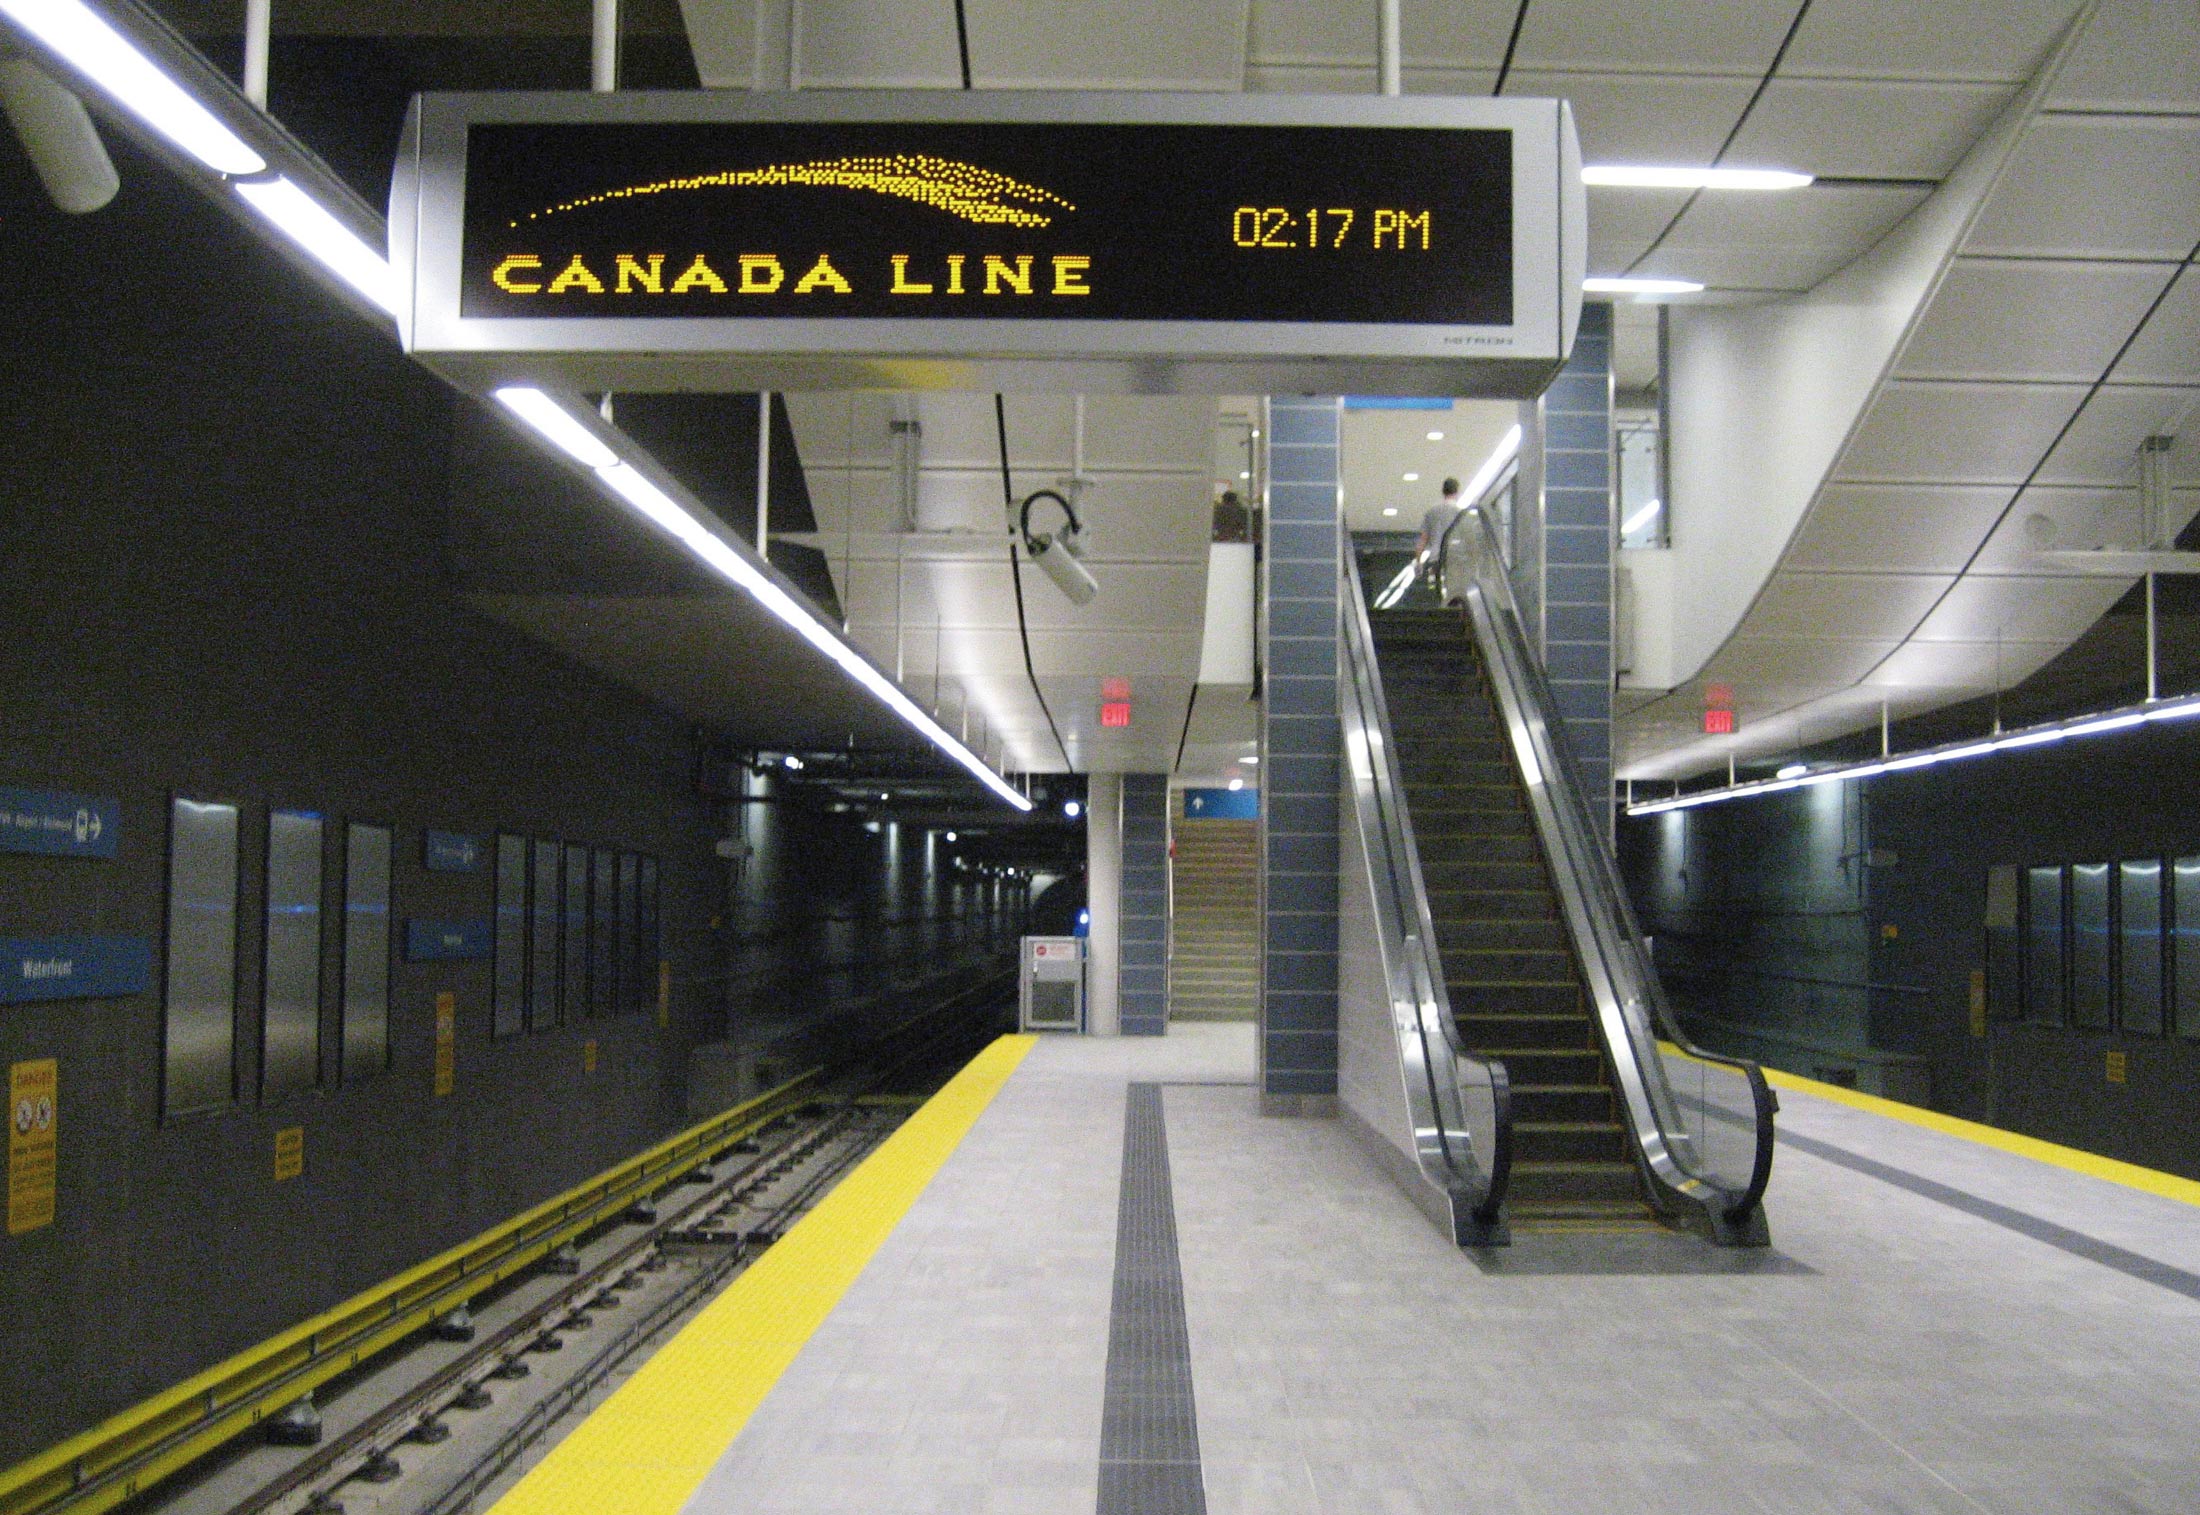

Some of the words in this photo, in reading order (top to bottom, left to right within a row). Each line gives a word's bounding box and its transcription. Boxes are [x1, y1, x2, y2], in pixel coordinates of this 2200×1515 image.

[1234, 208, 1353, 247] 02:17
[1374, 210, 1429, 249] PM
[493, 254, 852, 293] CANADA
[890, 255, 1090, 294] LINE
